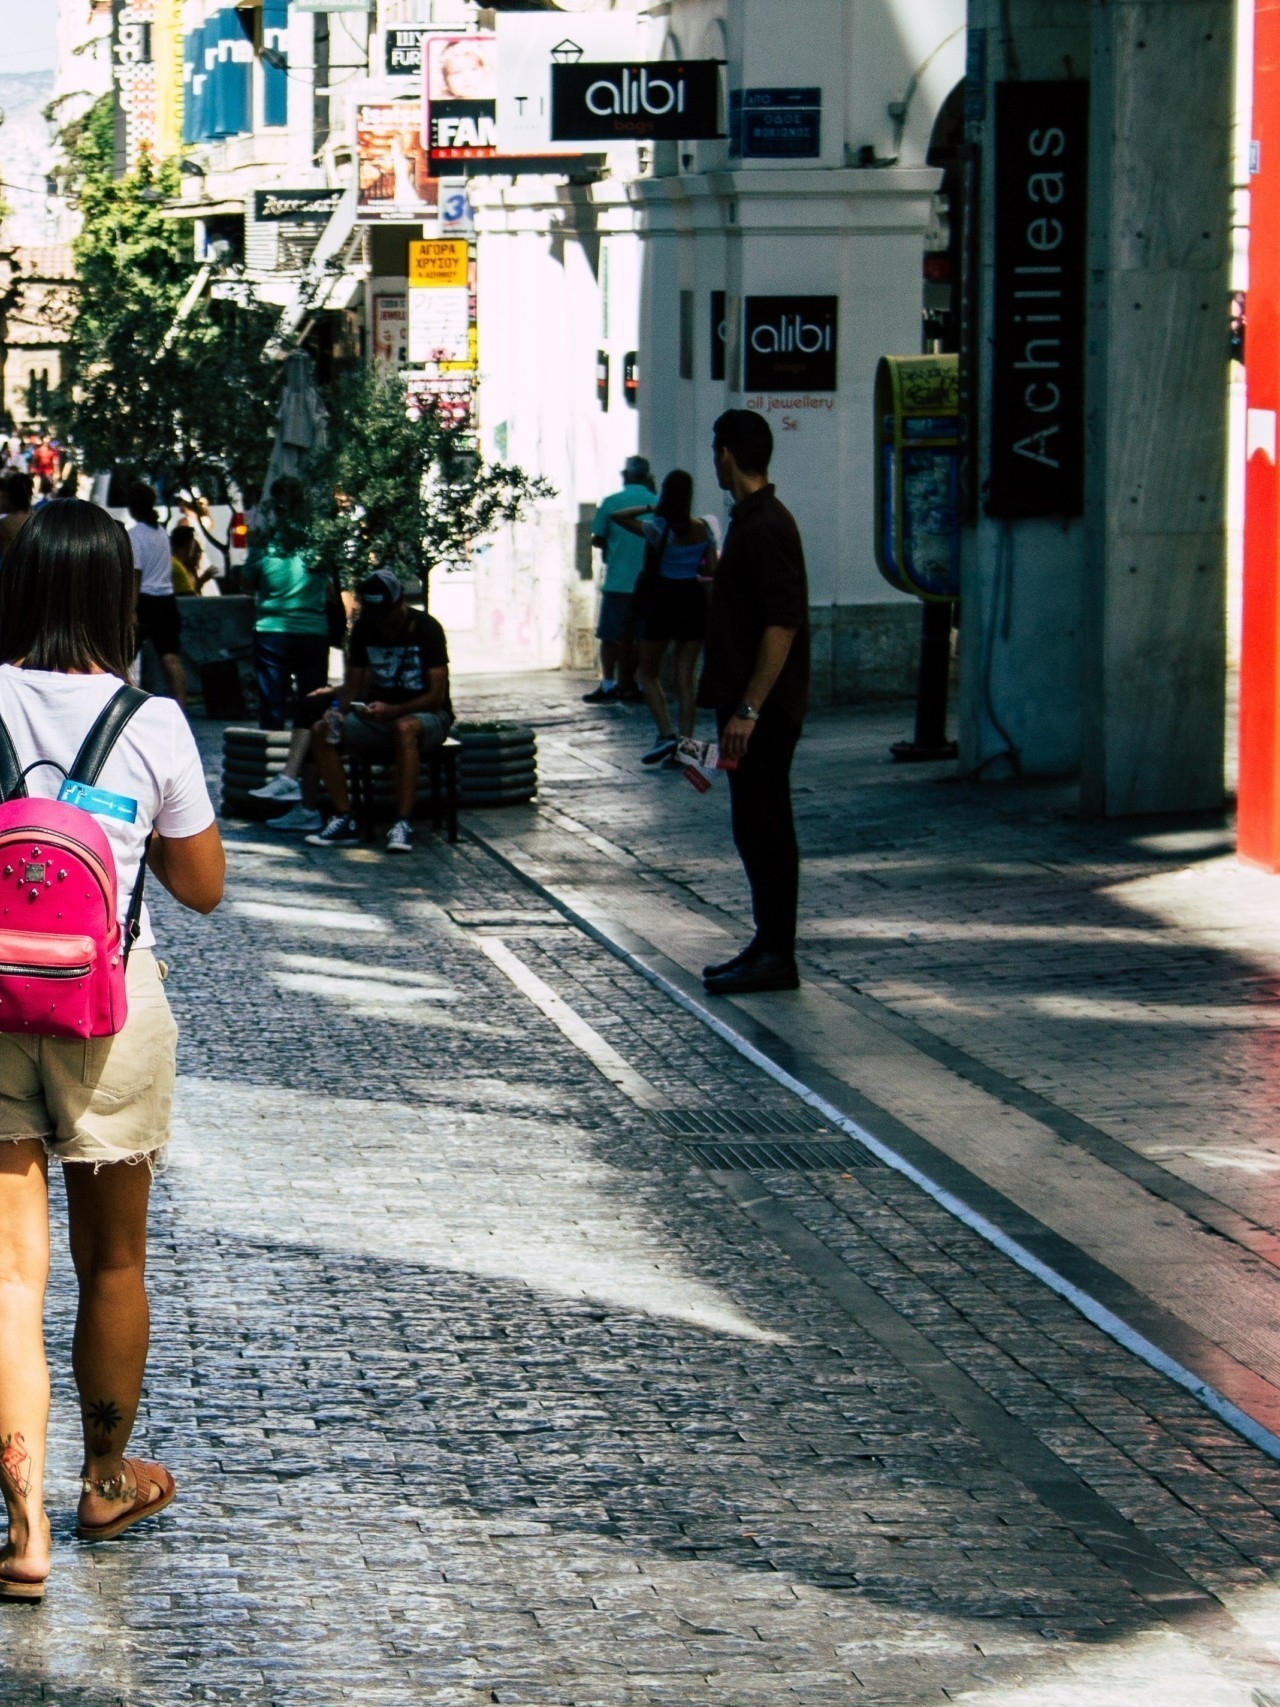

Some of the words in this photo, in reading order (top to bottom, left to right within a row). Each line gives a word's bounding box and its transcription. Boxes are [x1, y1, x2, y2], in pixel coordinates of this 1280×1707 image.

[585, 66, 685, 116] alibi
[763, 114, 801, 124] ΟΔΟΣ
[420, 243, 456, 255] ΑΓΟΡΑ
[416, 257, 459, 269] ΧΡΥΣΟΥ
[1012, 126, 1065, 469] Achilleas
[751, 313, 831, 353] alibi
[767, 395, 834, 412] jewellery
